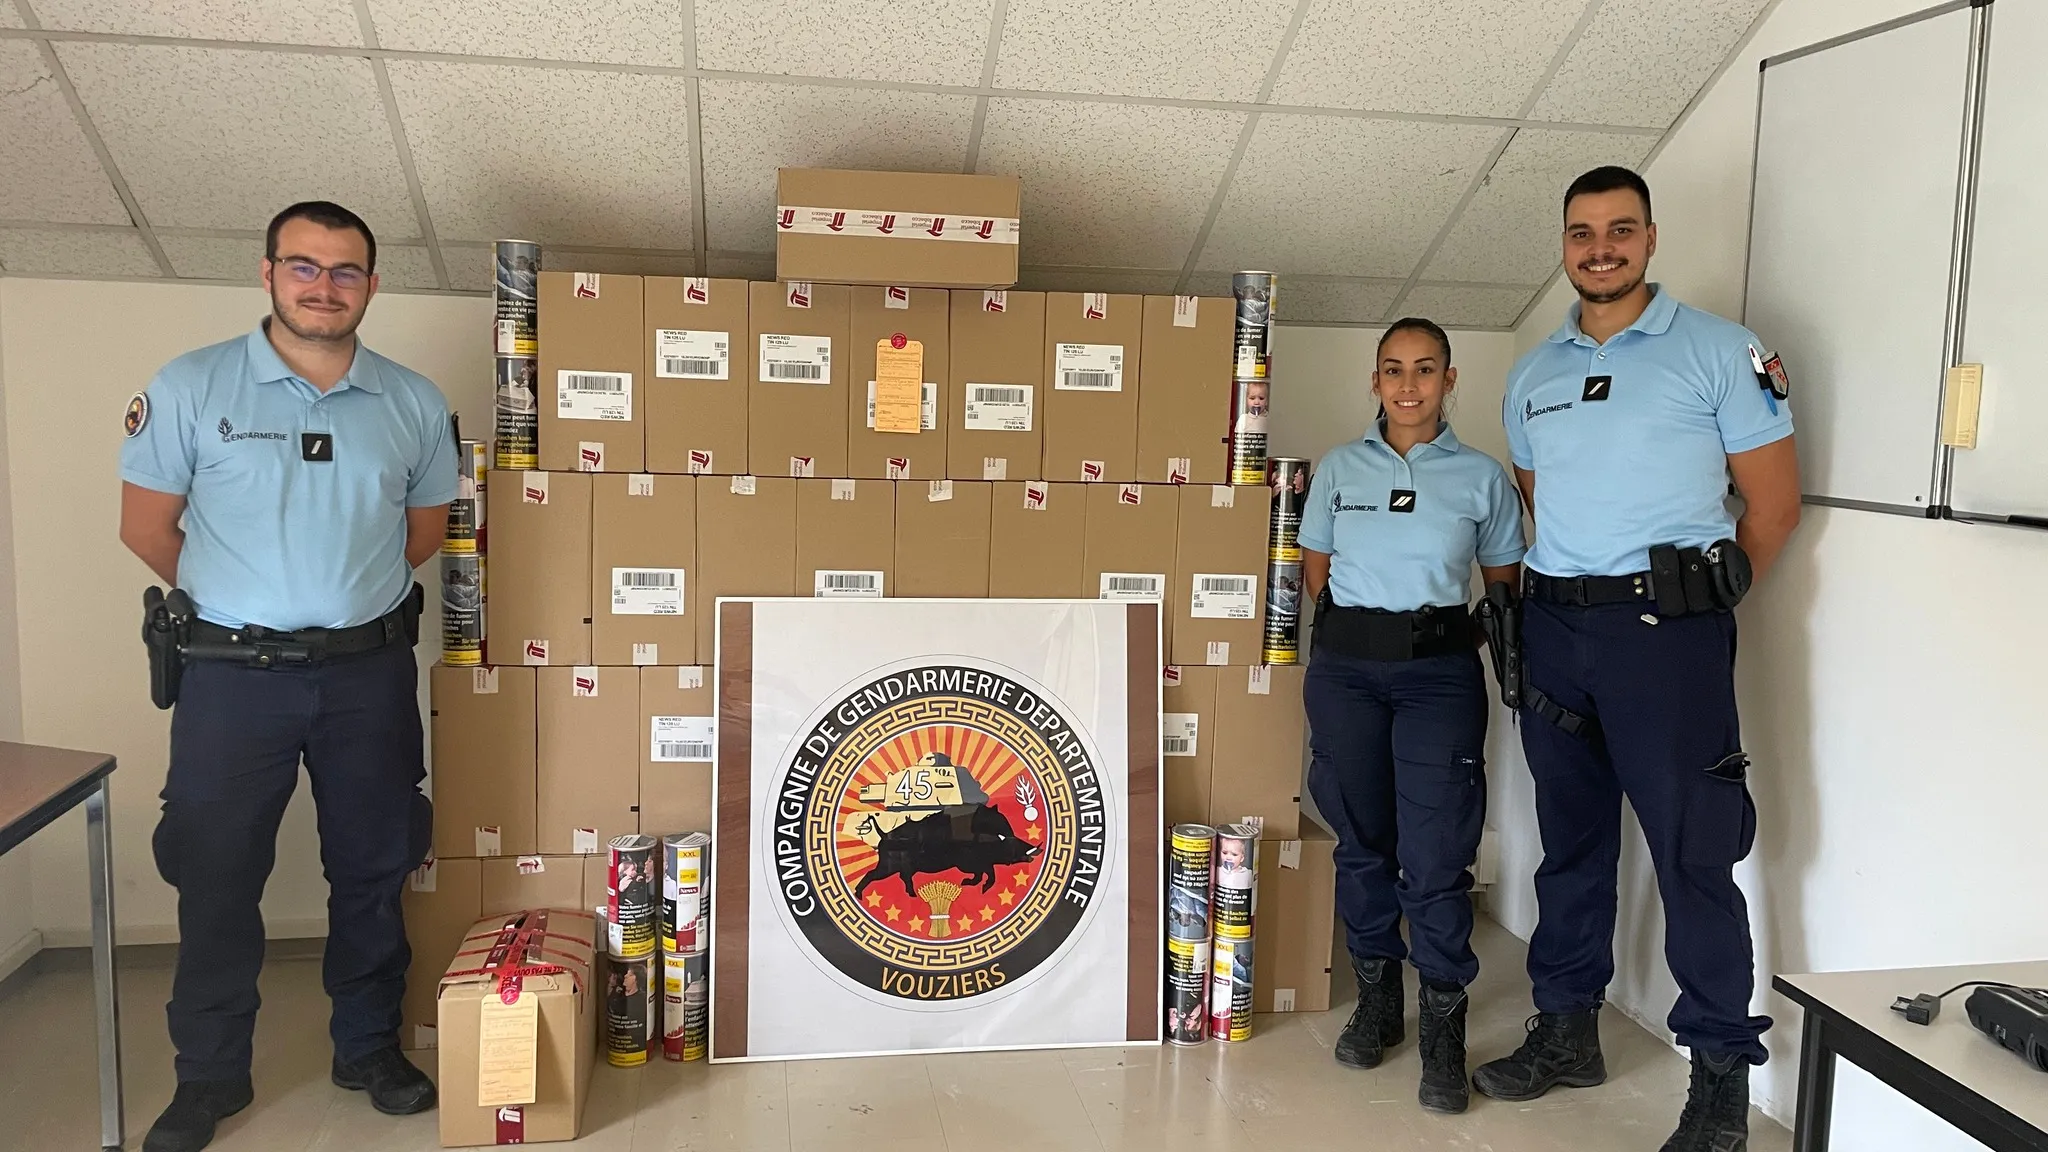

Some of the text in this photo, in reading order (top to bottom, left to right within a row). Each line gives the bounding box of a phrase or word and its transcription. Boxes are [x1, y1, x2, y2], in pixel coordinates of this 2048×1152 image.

[1526, 401, 1573, 421] GENDARMERIE
[223, 432, 288, 443] GENDARMERIE
[1335, 505, 1378, 513] GENDARMERIE
[778, 668, 1103, 917] COMPAGNIE DE GENDARMERIE DEPARTEMENTALE
[896, 770, 933, 800] 45
[881, 963, 1006, 998] VOUZIERS
